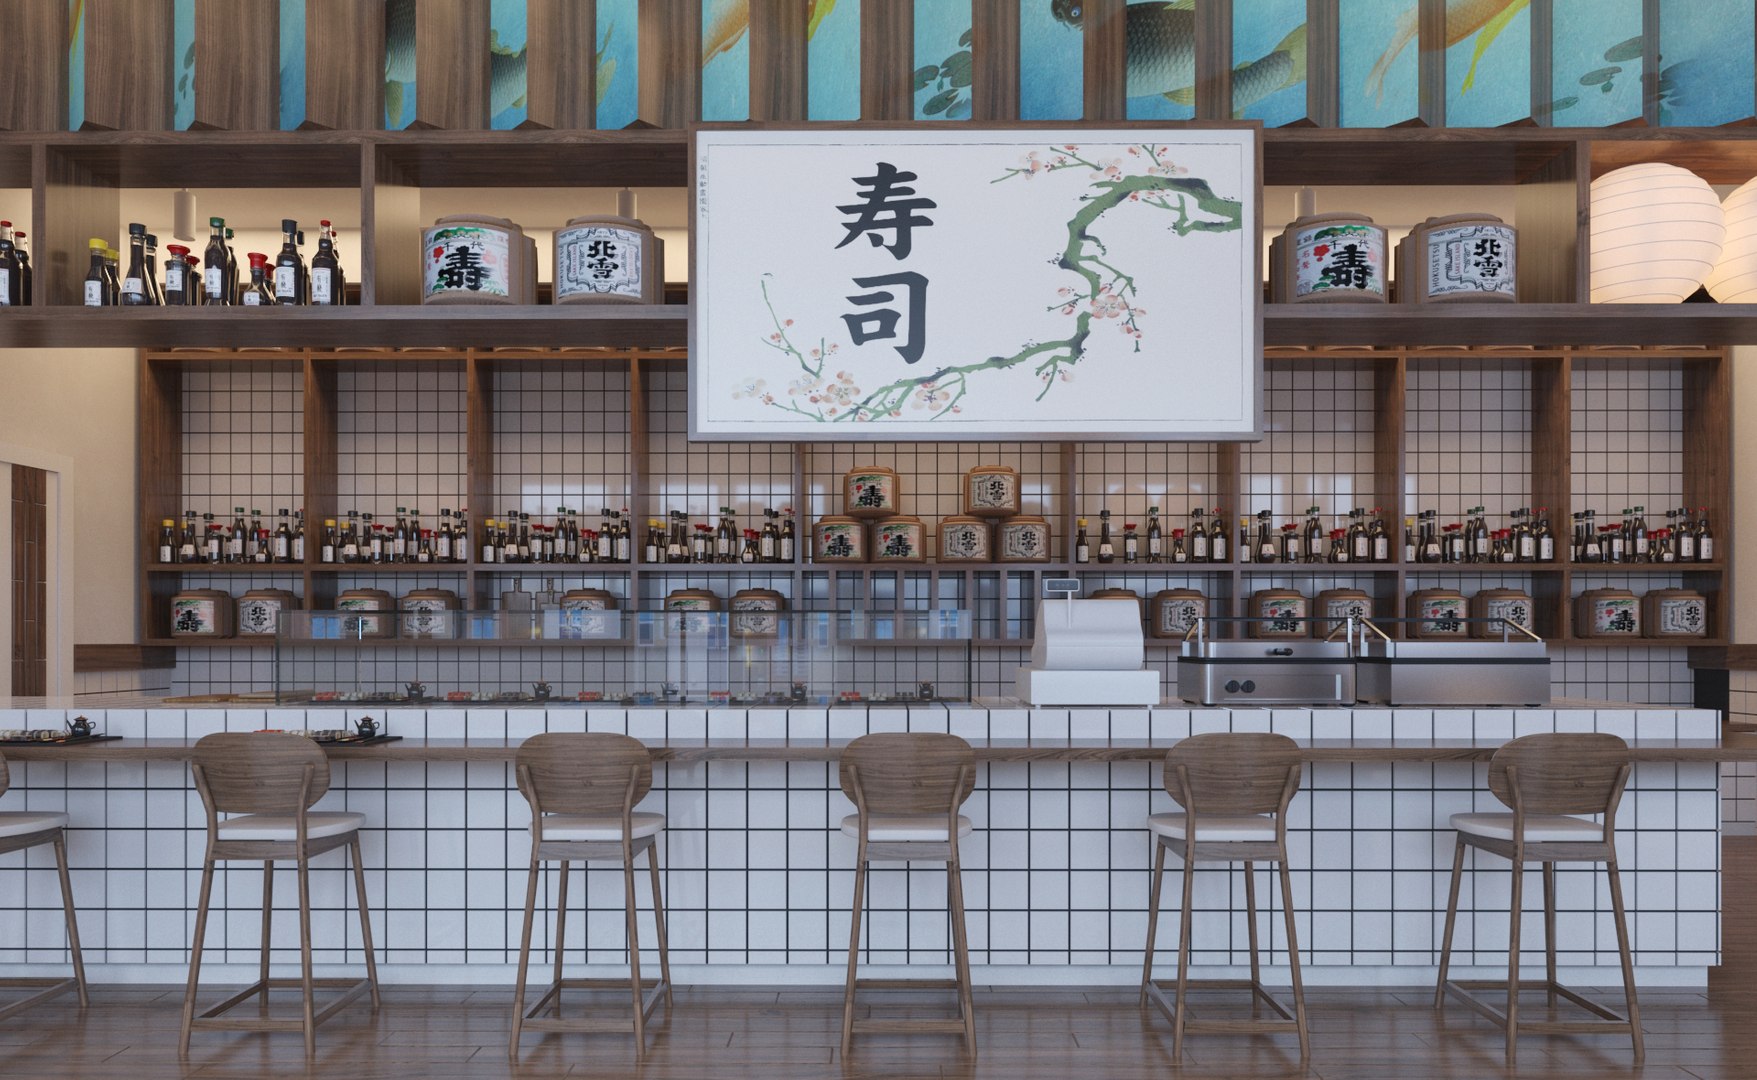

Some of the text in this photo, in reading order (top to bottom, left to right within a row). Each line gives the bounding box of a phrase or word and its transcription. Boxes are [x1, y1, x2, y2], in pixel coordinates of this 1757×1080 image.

[586, 240, 619, 279] 北雪
[834, 162, 937, 365] 寿司
[1432, 244, 1440, 288] HOKUSETSU
[1473, 238, 1503, 277] 北雪
